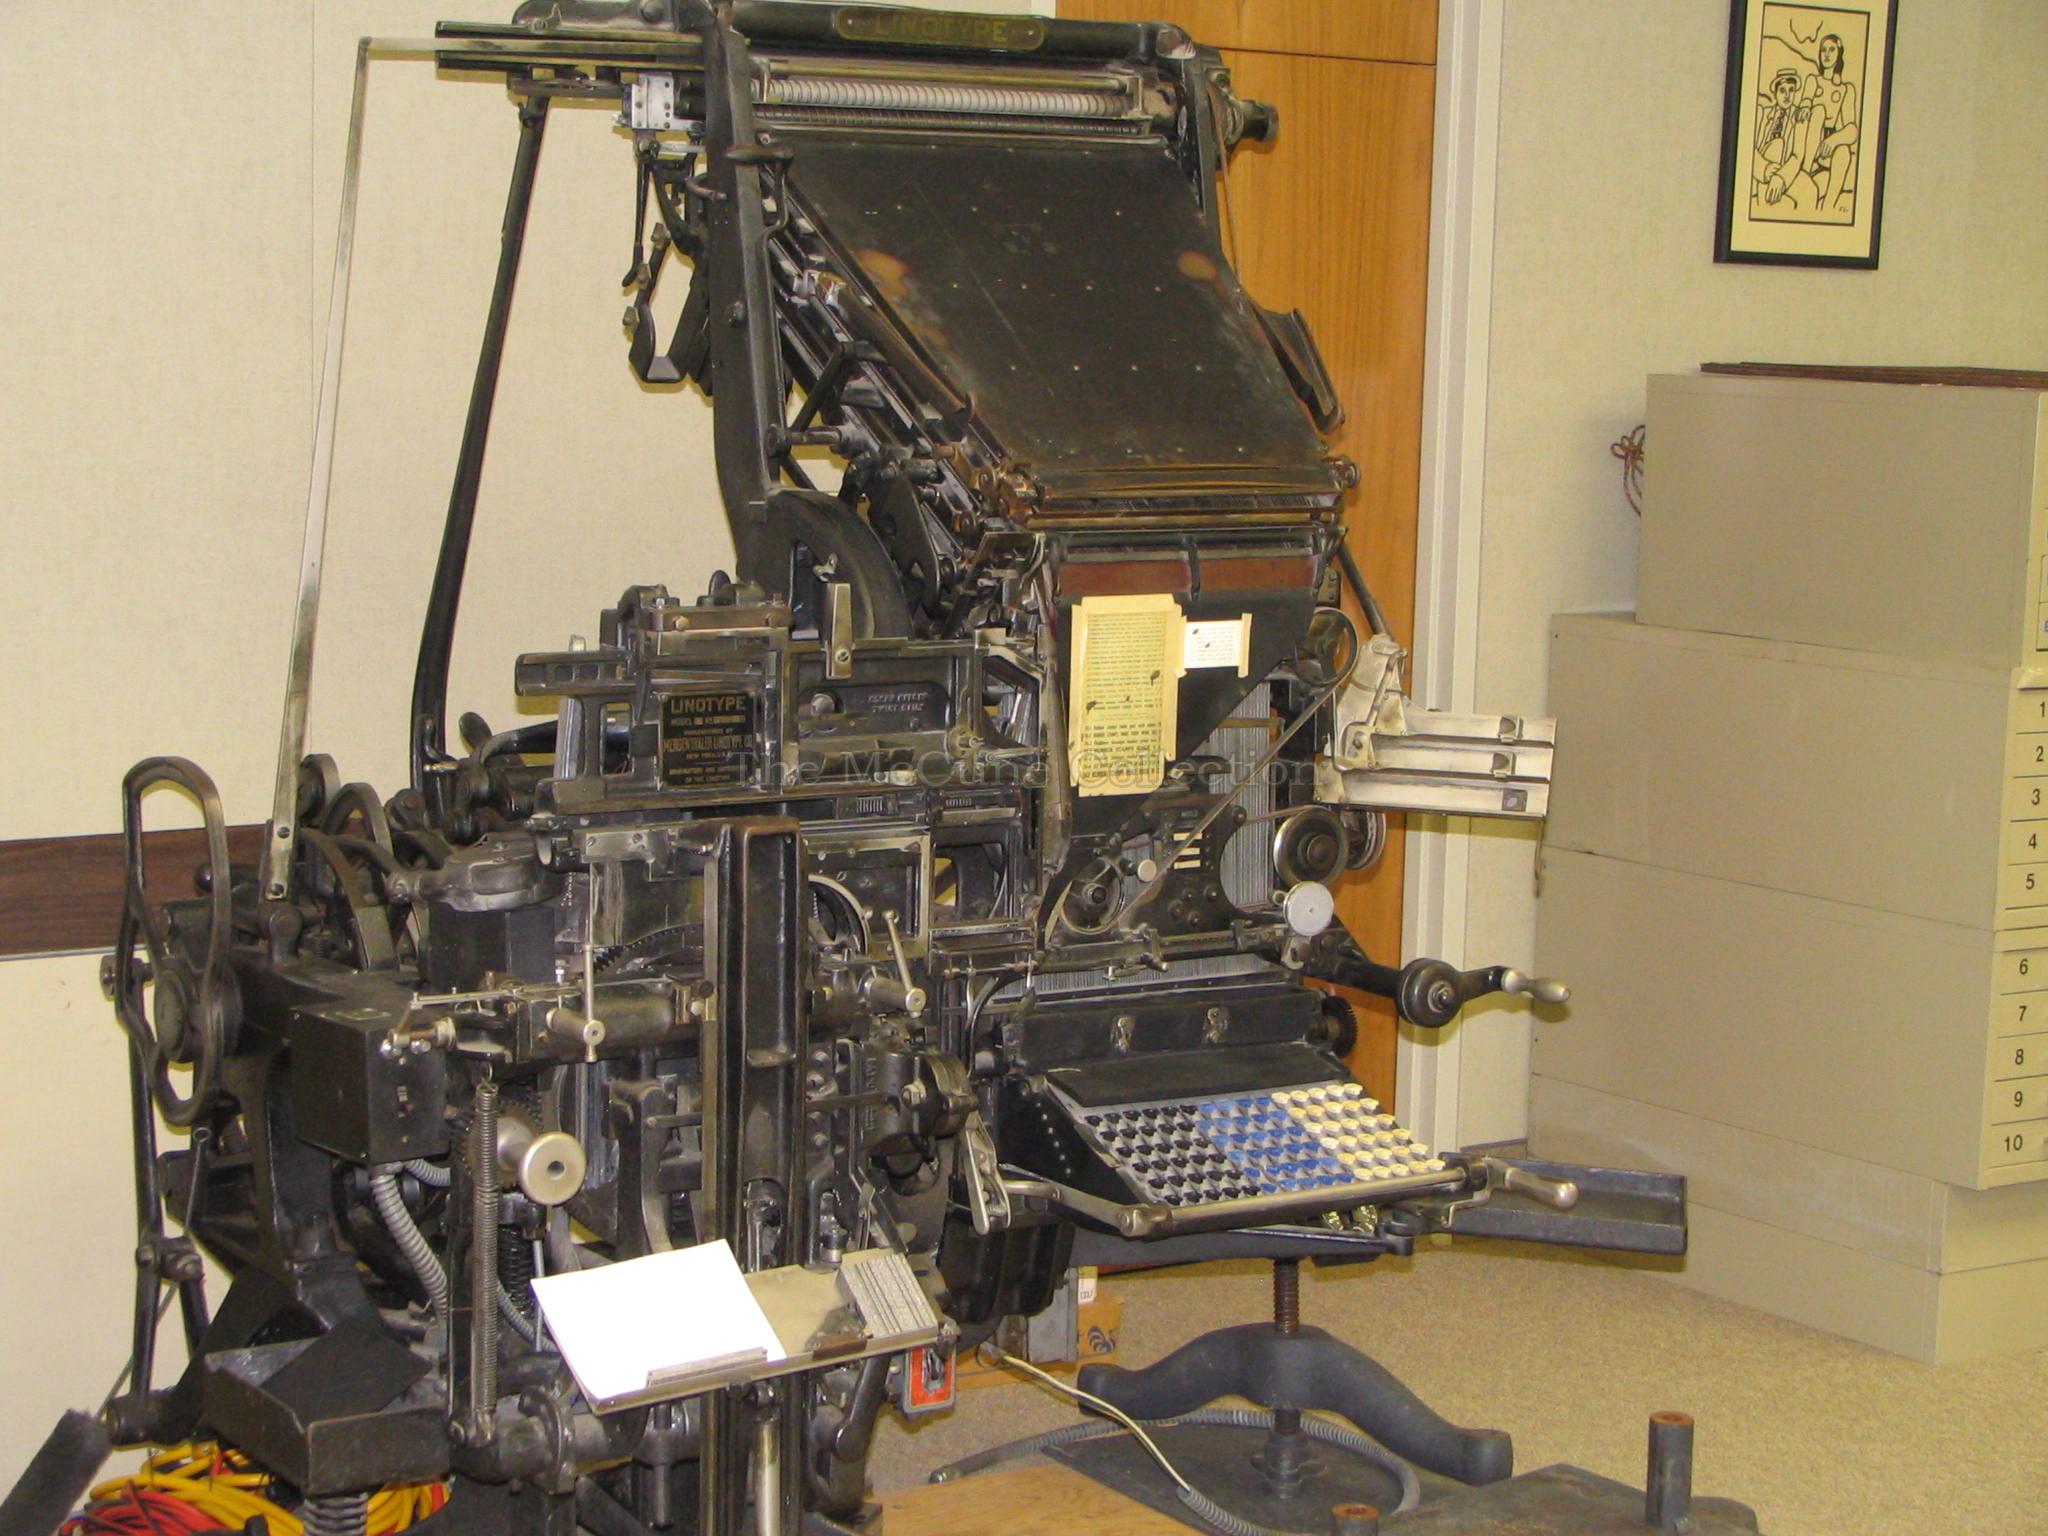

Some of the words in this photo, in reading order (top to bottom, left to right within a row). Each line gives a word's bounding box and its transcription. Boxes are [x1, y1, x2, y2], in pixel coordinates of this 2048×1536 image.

[875, 14, 1008, 42] LINOTYPE
[671, 696, 746, 713] LINOTYPE
[2039, 701, 2046, 718] 1
[2035, 745, 2044, 763] 2
[2031, 788, 2041, 806] 3
[2028, 833, 2038, 850] 4
[2025, 873, 2035, 890] 5
[2018, 958, 2029, 976] 6
[2018, 1005, 2028, 1022] 7
[2014, 1048, 2025, 1066] 8
[2013, 1091, 2024, 1108] 9
[2003, 1134, 2024, 1153] 10
